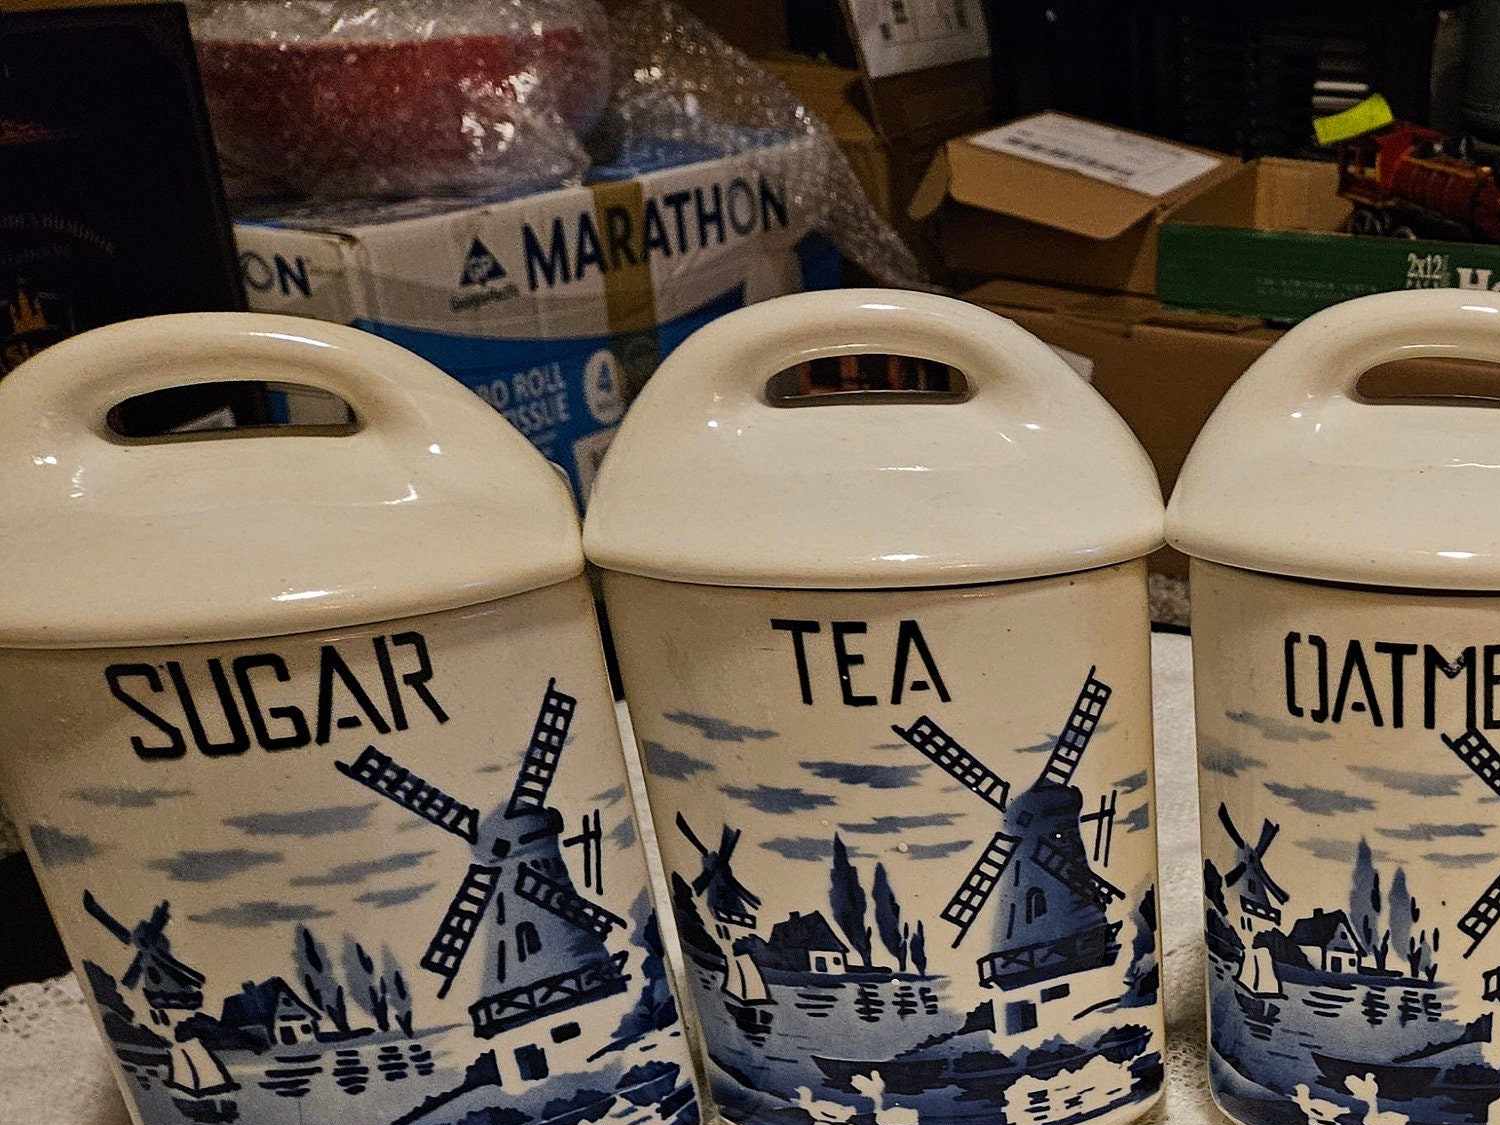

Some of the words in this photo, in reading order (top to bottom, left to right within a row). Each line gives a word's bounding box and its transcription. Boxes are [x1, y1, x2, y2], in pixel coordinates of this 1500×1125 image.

[522, 172, 789, 291] MARATHON
[104, 631, 449, 760] SUGAR
[770, 619, 951, 706] TEA
